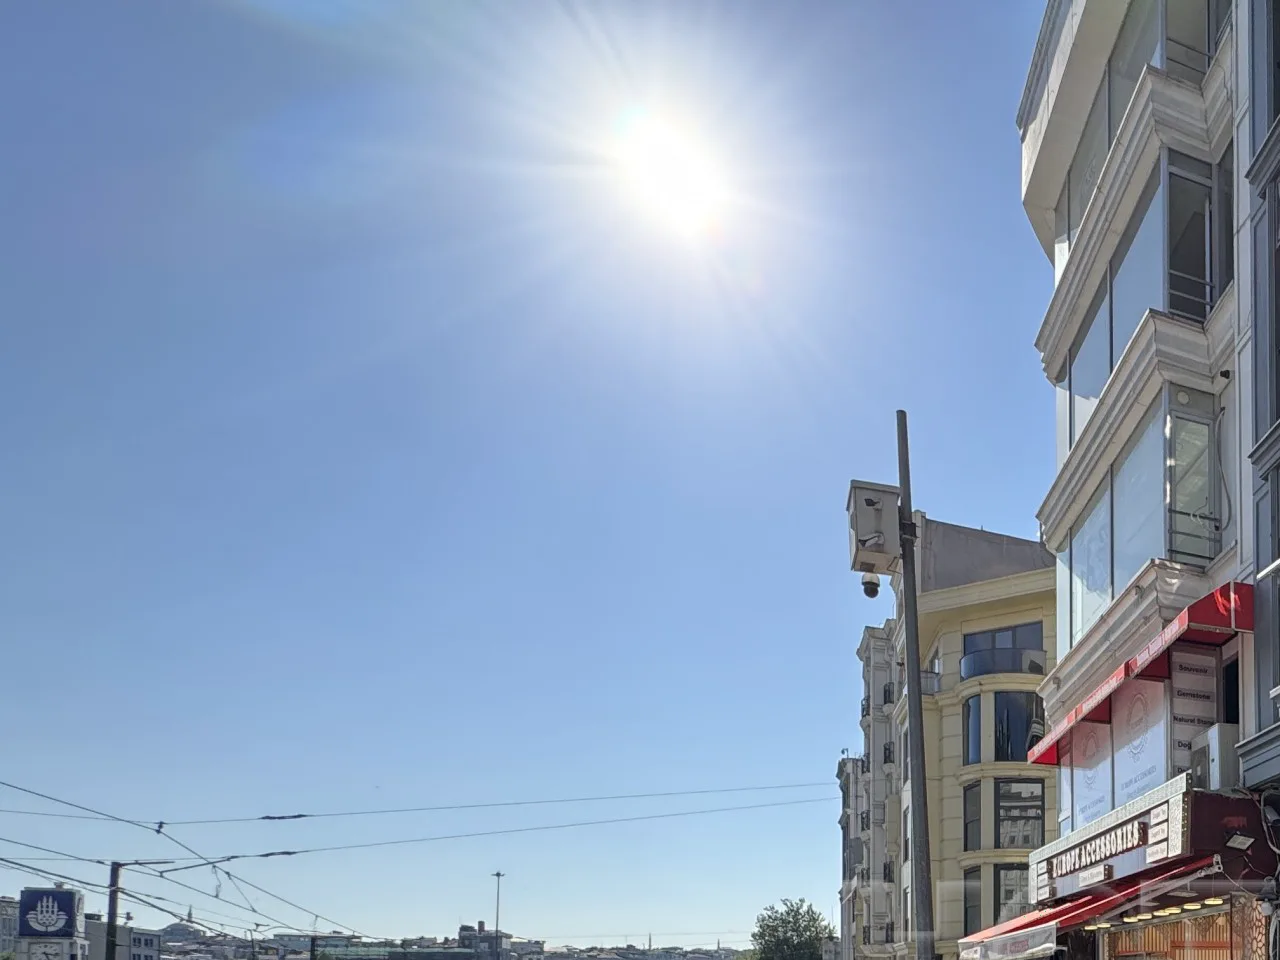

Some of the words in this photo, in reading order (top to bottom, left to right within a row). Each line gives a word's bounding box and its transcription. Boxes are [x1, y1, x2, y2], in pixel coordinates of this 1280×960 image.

[1177, 690, 1211, 701] Gemstone
[1052, 847, 1080, 879] EUROPE
[1080, 820, 1140, 868] ACCESSORIES
